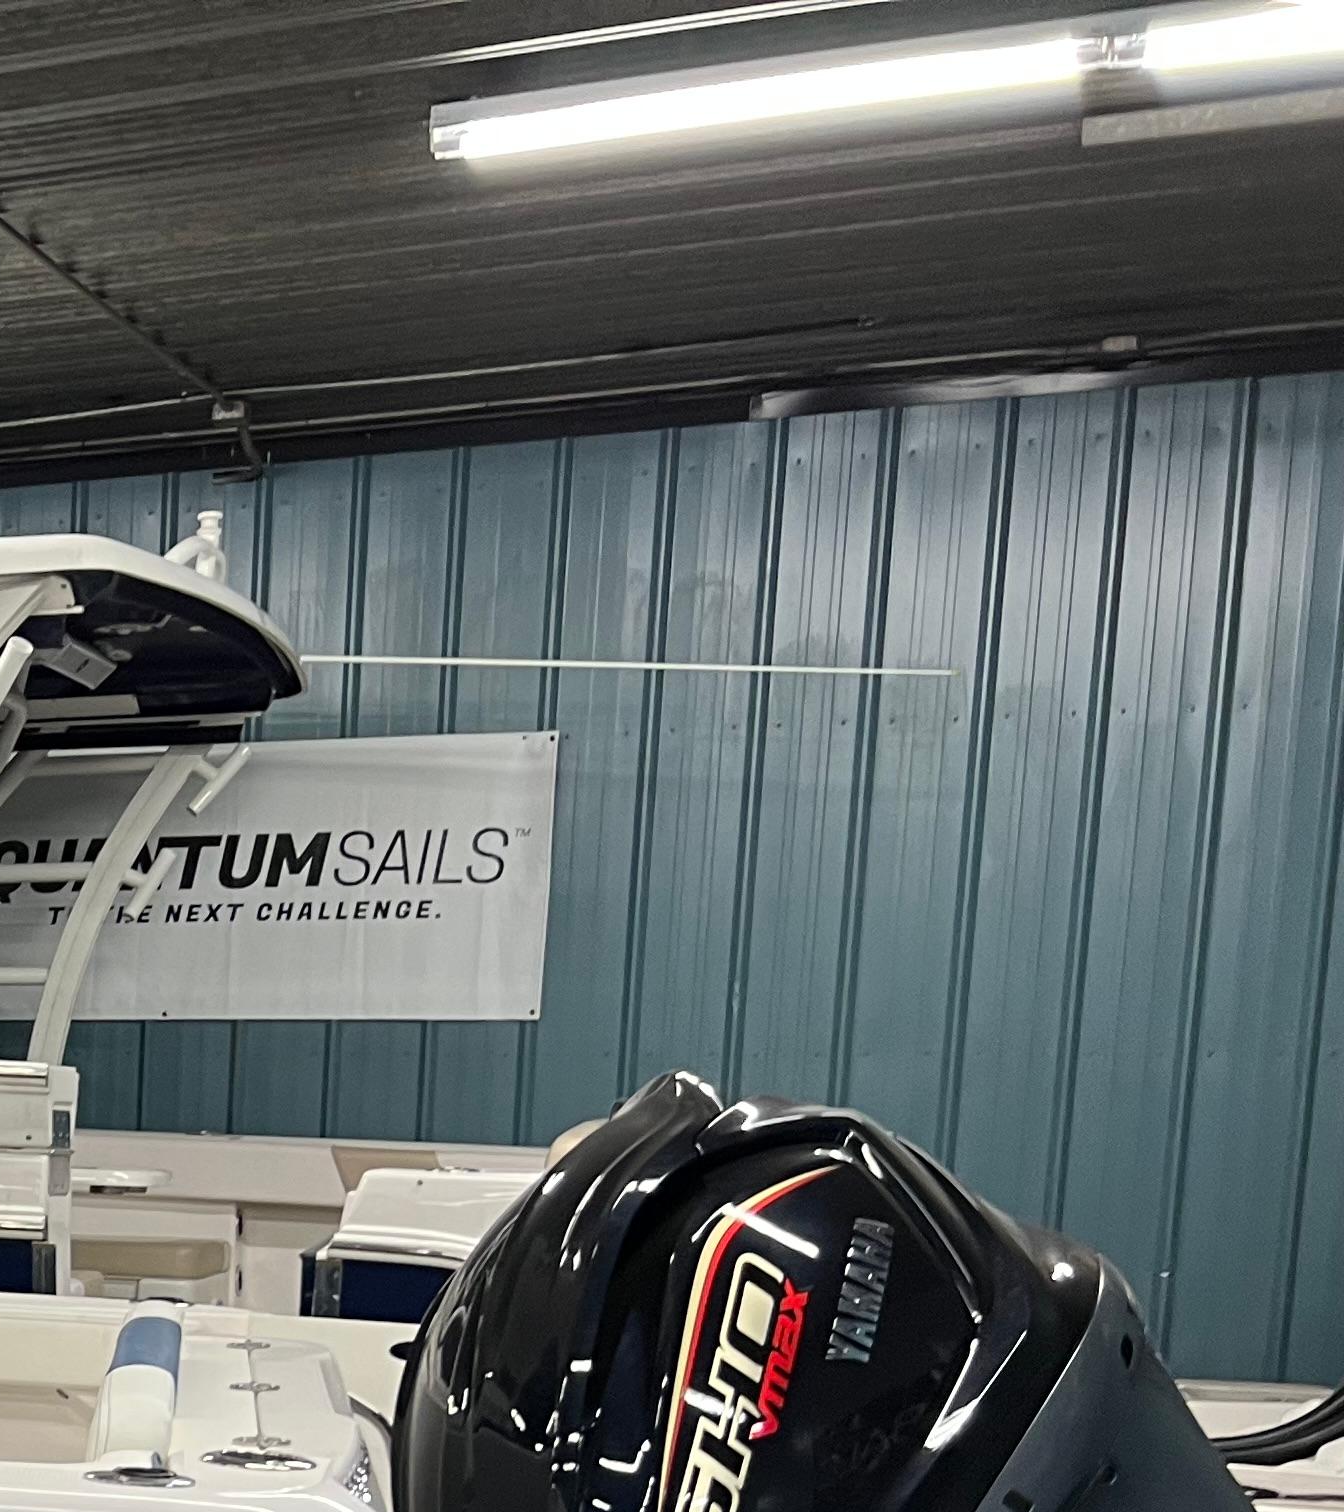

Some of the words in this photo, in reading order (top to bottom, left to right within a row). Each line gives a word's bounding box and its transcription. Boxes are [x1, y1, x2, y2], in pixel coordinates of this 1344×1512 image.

[165, 902, 244, 922] NEXT
[256, 900, 442, 922] CHALLENGE.
[825, 1217, 895, 1363] YAMAHA
